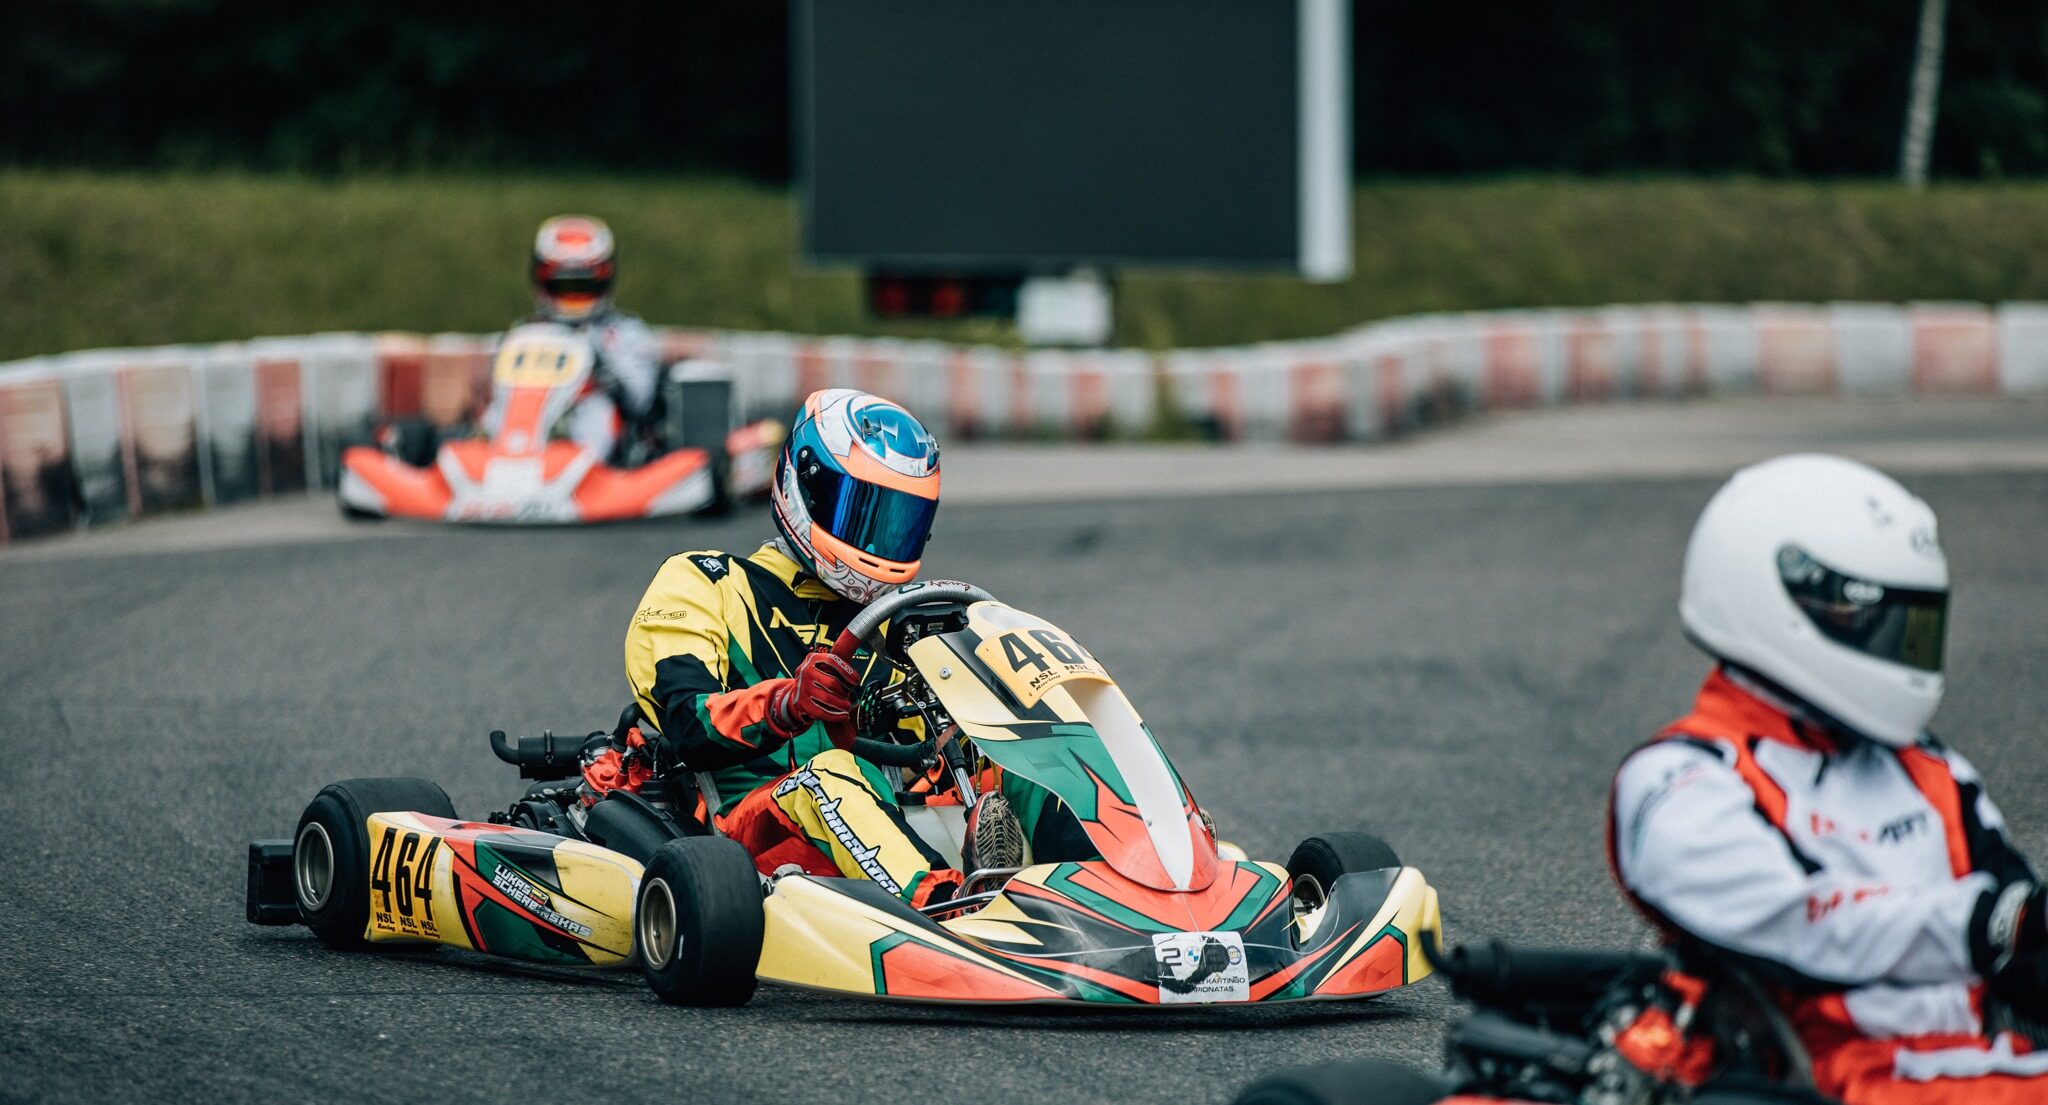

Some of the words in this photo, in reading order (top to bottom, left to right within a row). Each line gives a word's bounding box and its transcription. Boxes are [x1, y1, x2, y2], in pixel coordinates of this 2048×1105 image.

[999, 629, 1094, 673] 46
[1029, 669, 1058, 688] NSL
[1064, 664, 1093, 672] NSL
[371, 826, 442, 921] 464
[494, 863, 531, 896] LUKAS
[376, 911, 396, 924] NSL
[400, 916, 418, 928] NSL
[420, 920, 438, 932] NSL
